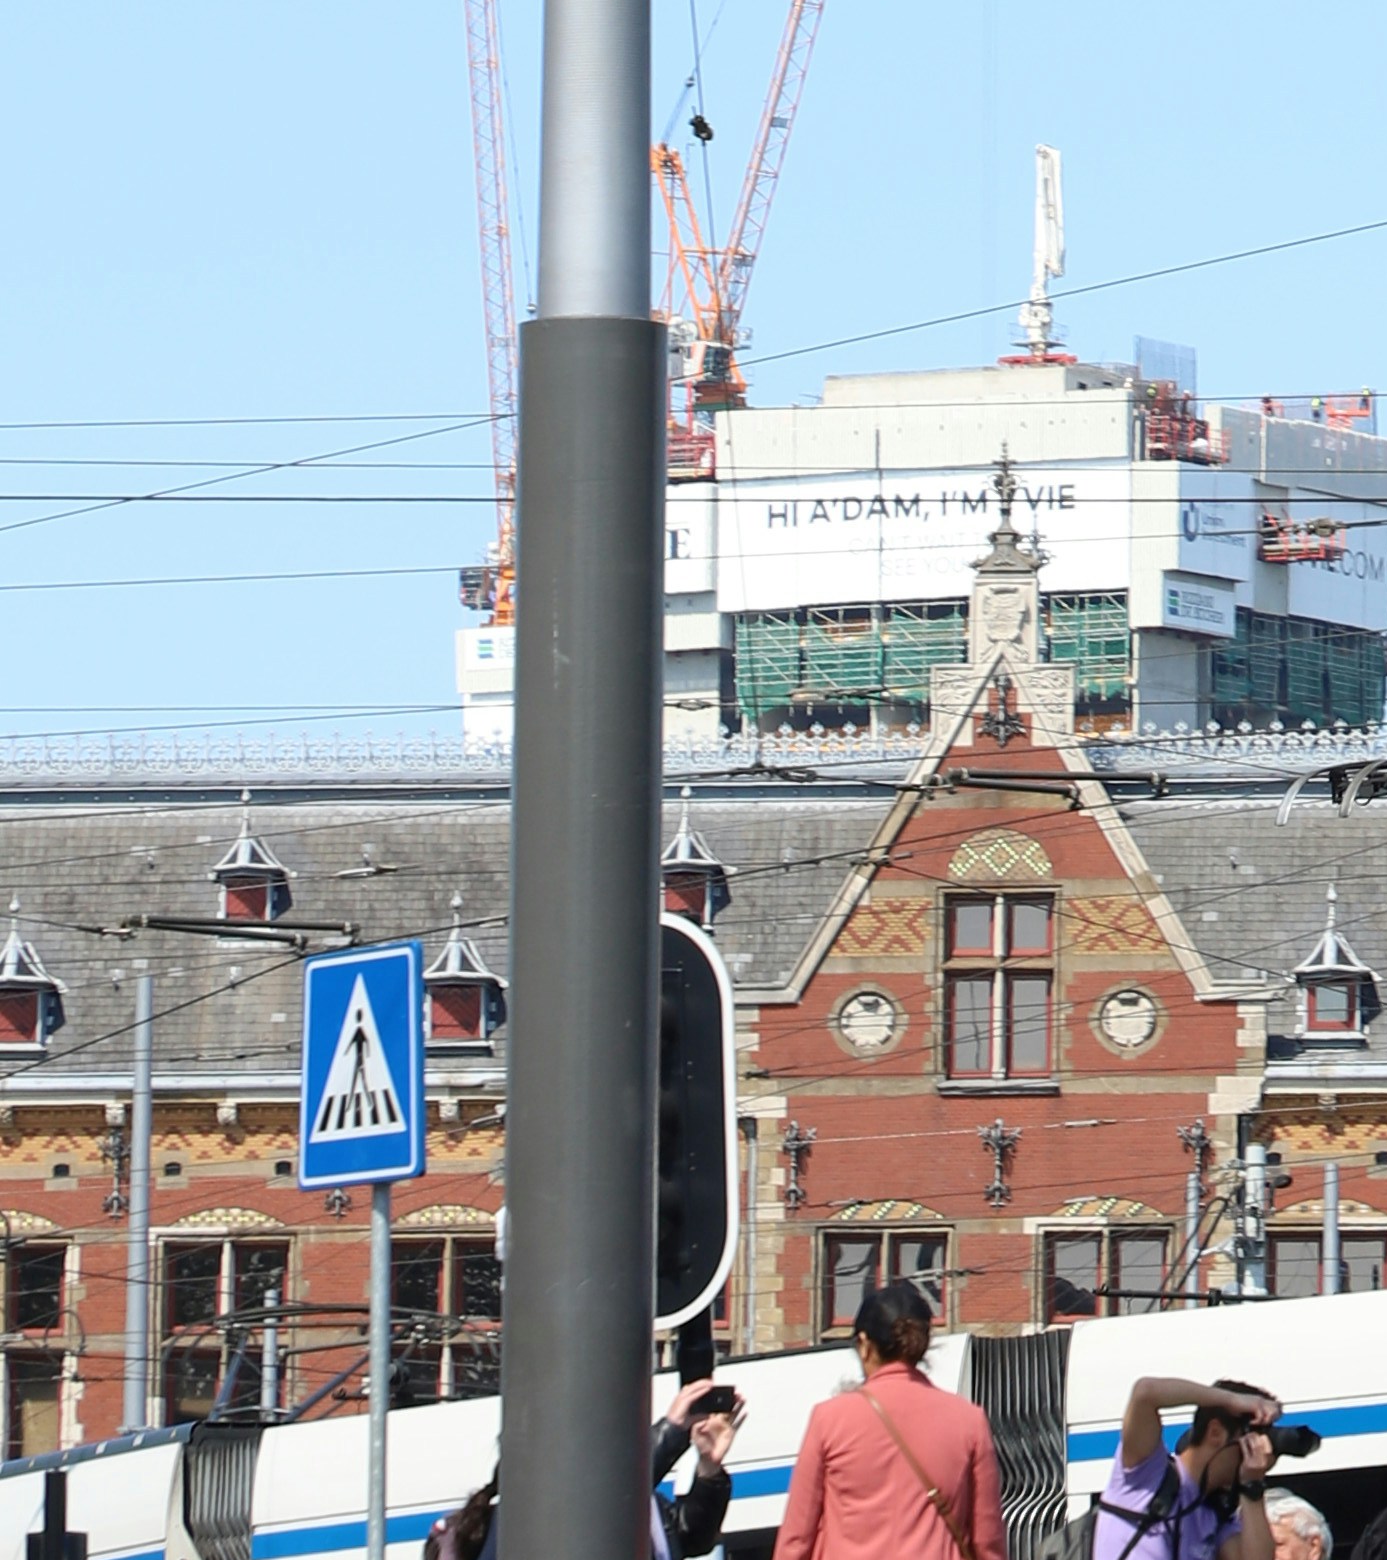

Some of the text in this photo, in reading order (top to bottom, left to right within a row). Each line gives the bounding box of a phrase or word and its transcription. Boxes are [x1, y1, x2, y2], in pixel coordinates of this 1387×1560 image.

[768, 502, 798, 528] HI
[809, 493, 930, 523] A'DAM,
[941, 489, 987, 517] I'M
